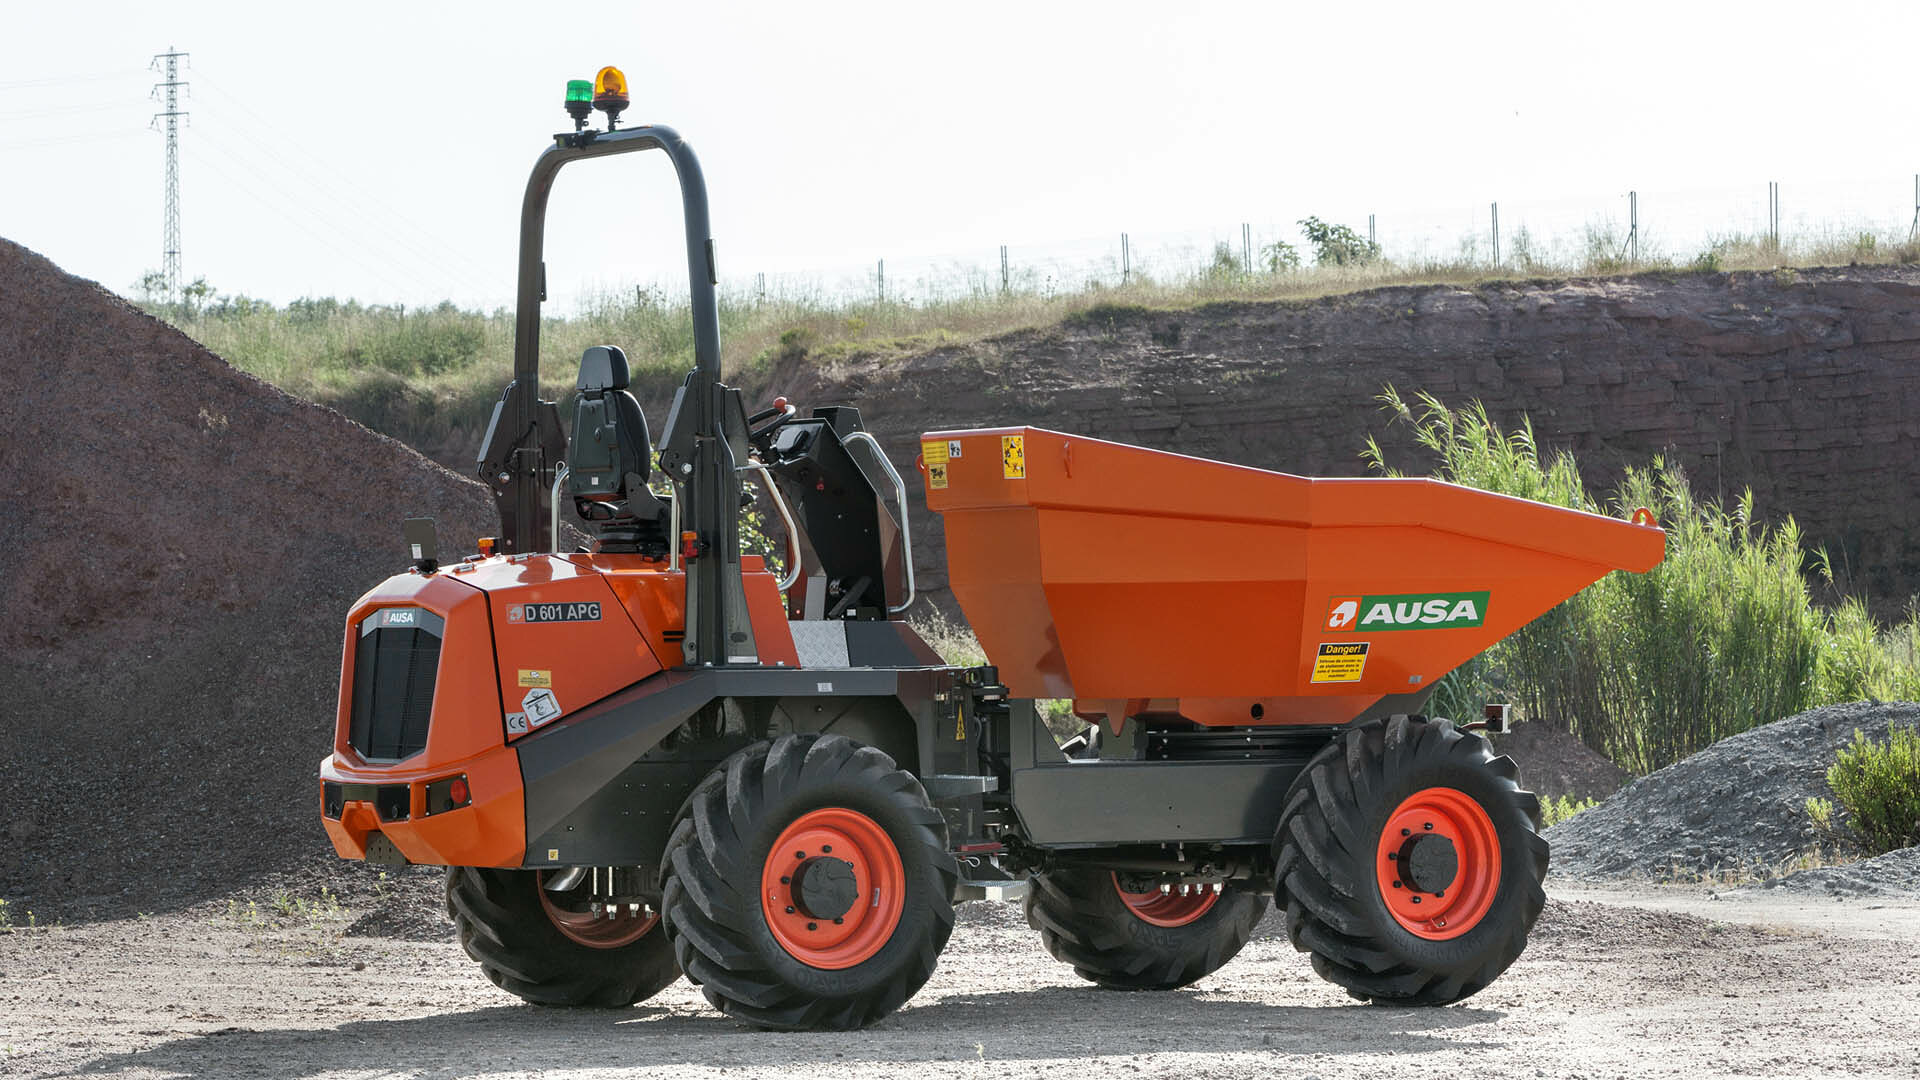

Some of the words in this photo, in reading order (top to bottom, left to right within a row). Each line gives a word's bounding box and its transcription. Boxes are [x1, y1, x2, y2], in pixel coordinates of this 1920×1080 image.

[389, 612, 414, 623] AUSA
[525, 605, 537, 621] D
[539, 605, 563, 621] 601
[566, 603, 600, 620] APG
[1361, 600, 1478, 624] AUSA
[1326, 645, 1361, 655] Danger!
